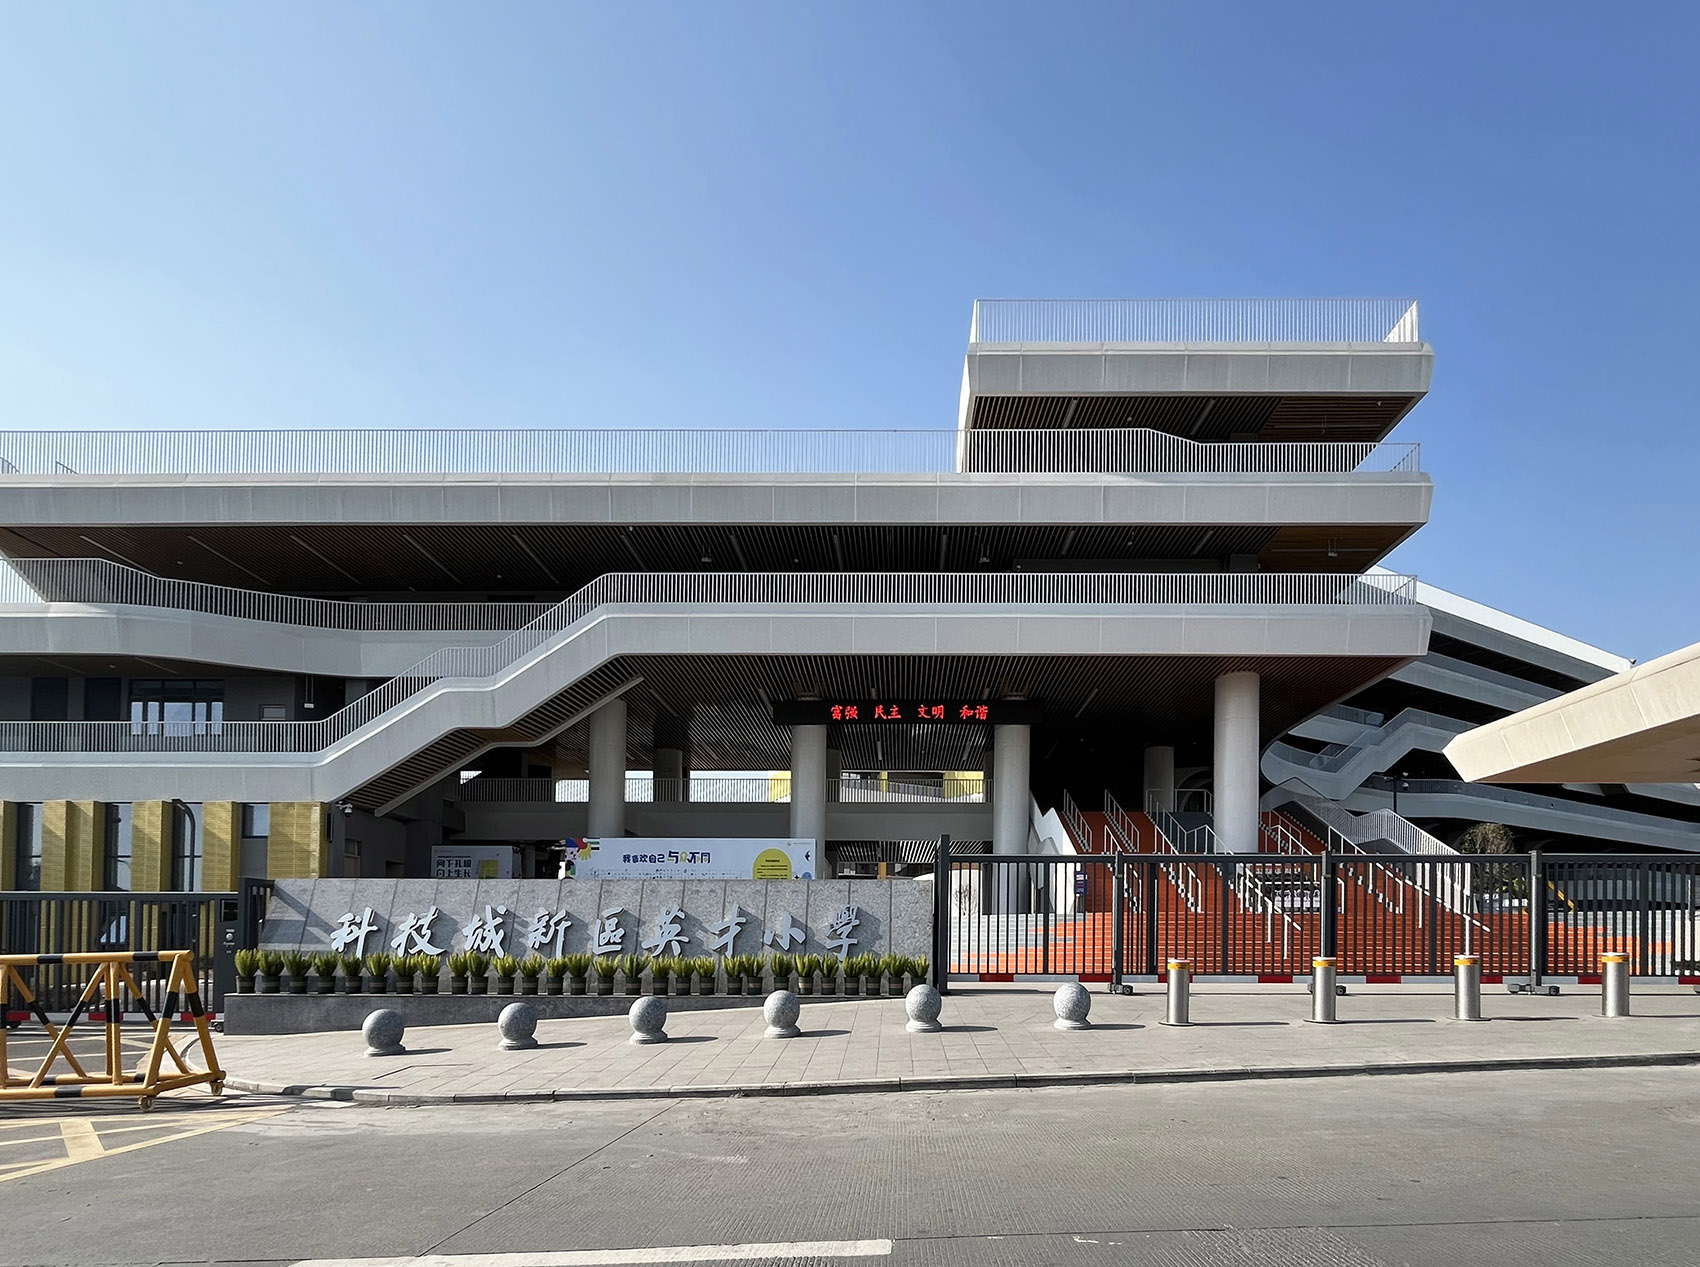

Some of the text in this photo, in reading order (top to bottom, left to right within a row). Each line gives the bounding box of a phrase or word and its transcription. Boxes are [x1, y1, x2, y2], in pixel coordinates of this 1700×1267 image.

[831, 704, 989, 720] 富强 民主 文明 和谐
